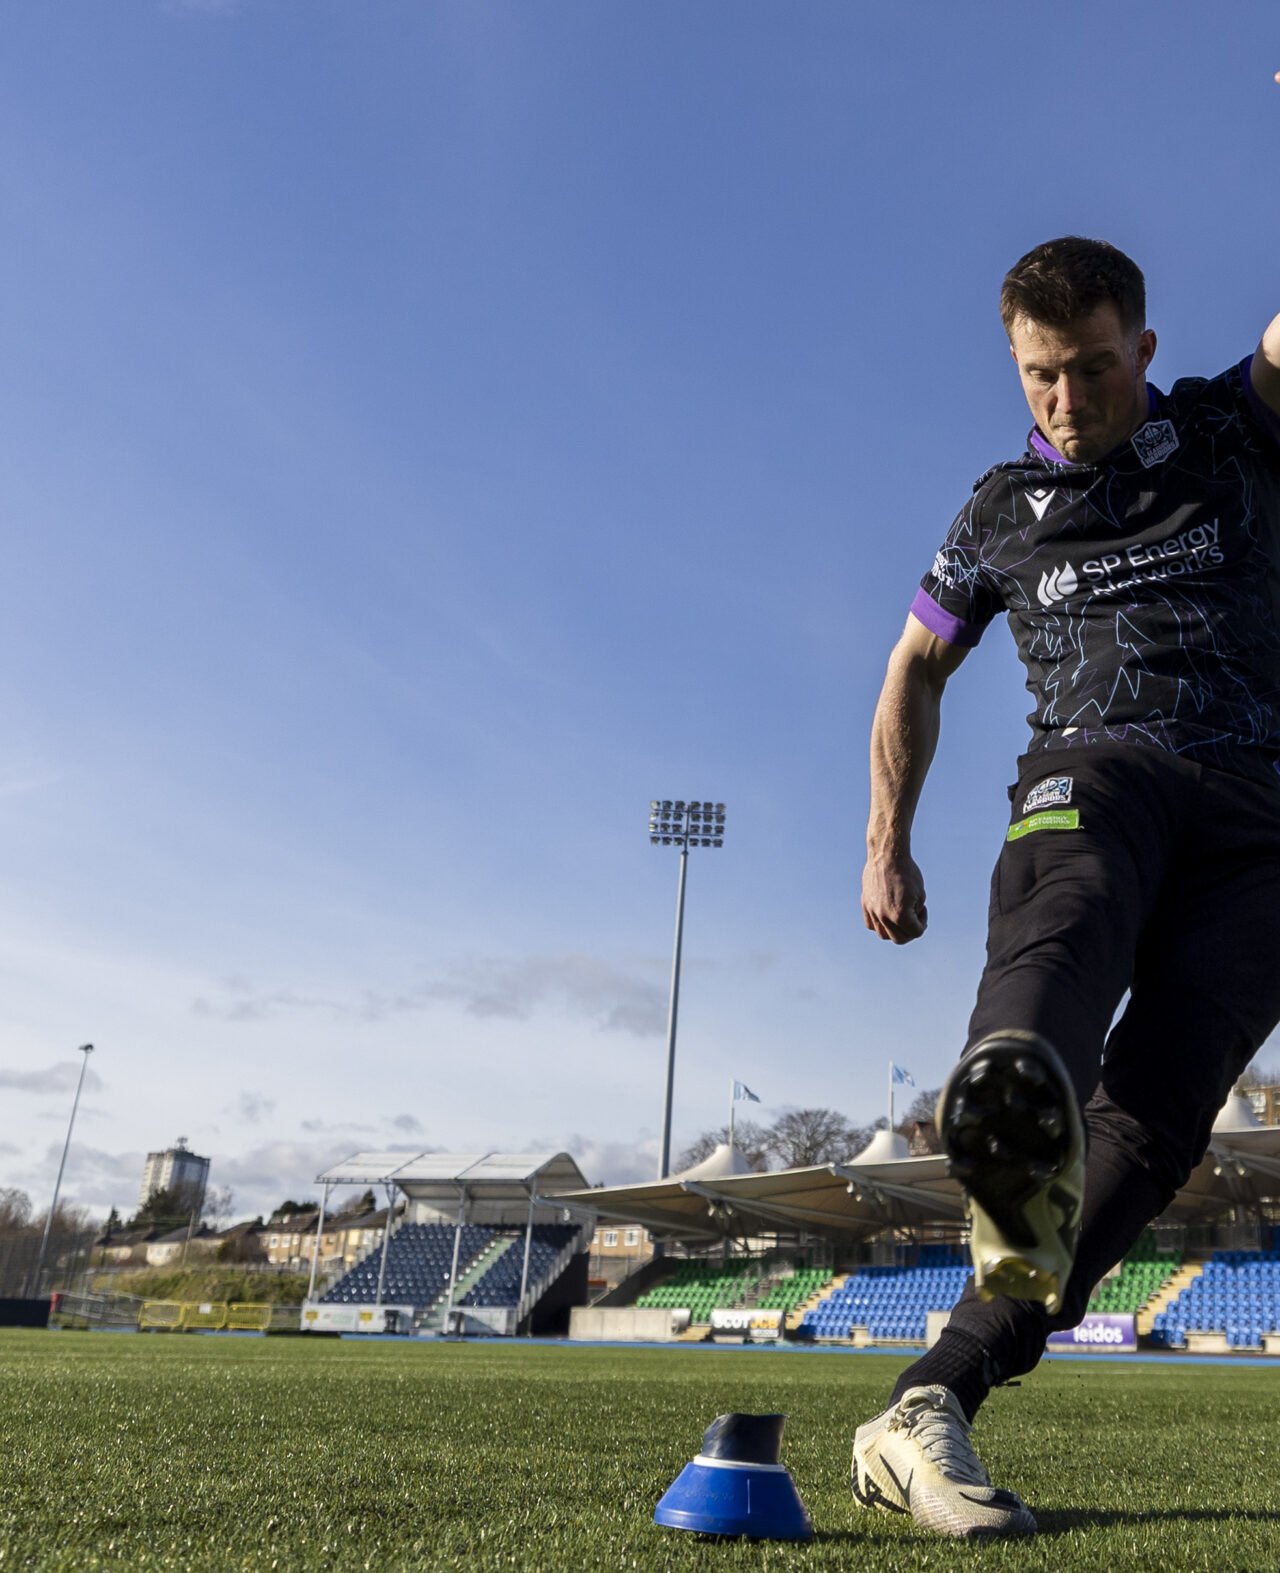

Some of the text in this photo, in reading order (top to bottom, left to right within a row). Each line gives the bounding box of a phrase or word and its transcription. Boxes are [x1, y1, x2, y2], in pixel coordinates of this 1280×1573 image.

[1082, 517, 1219, 582] SP Energy
[1073, 1321, 1123, 1343] leidos
